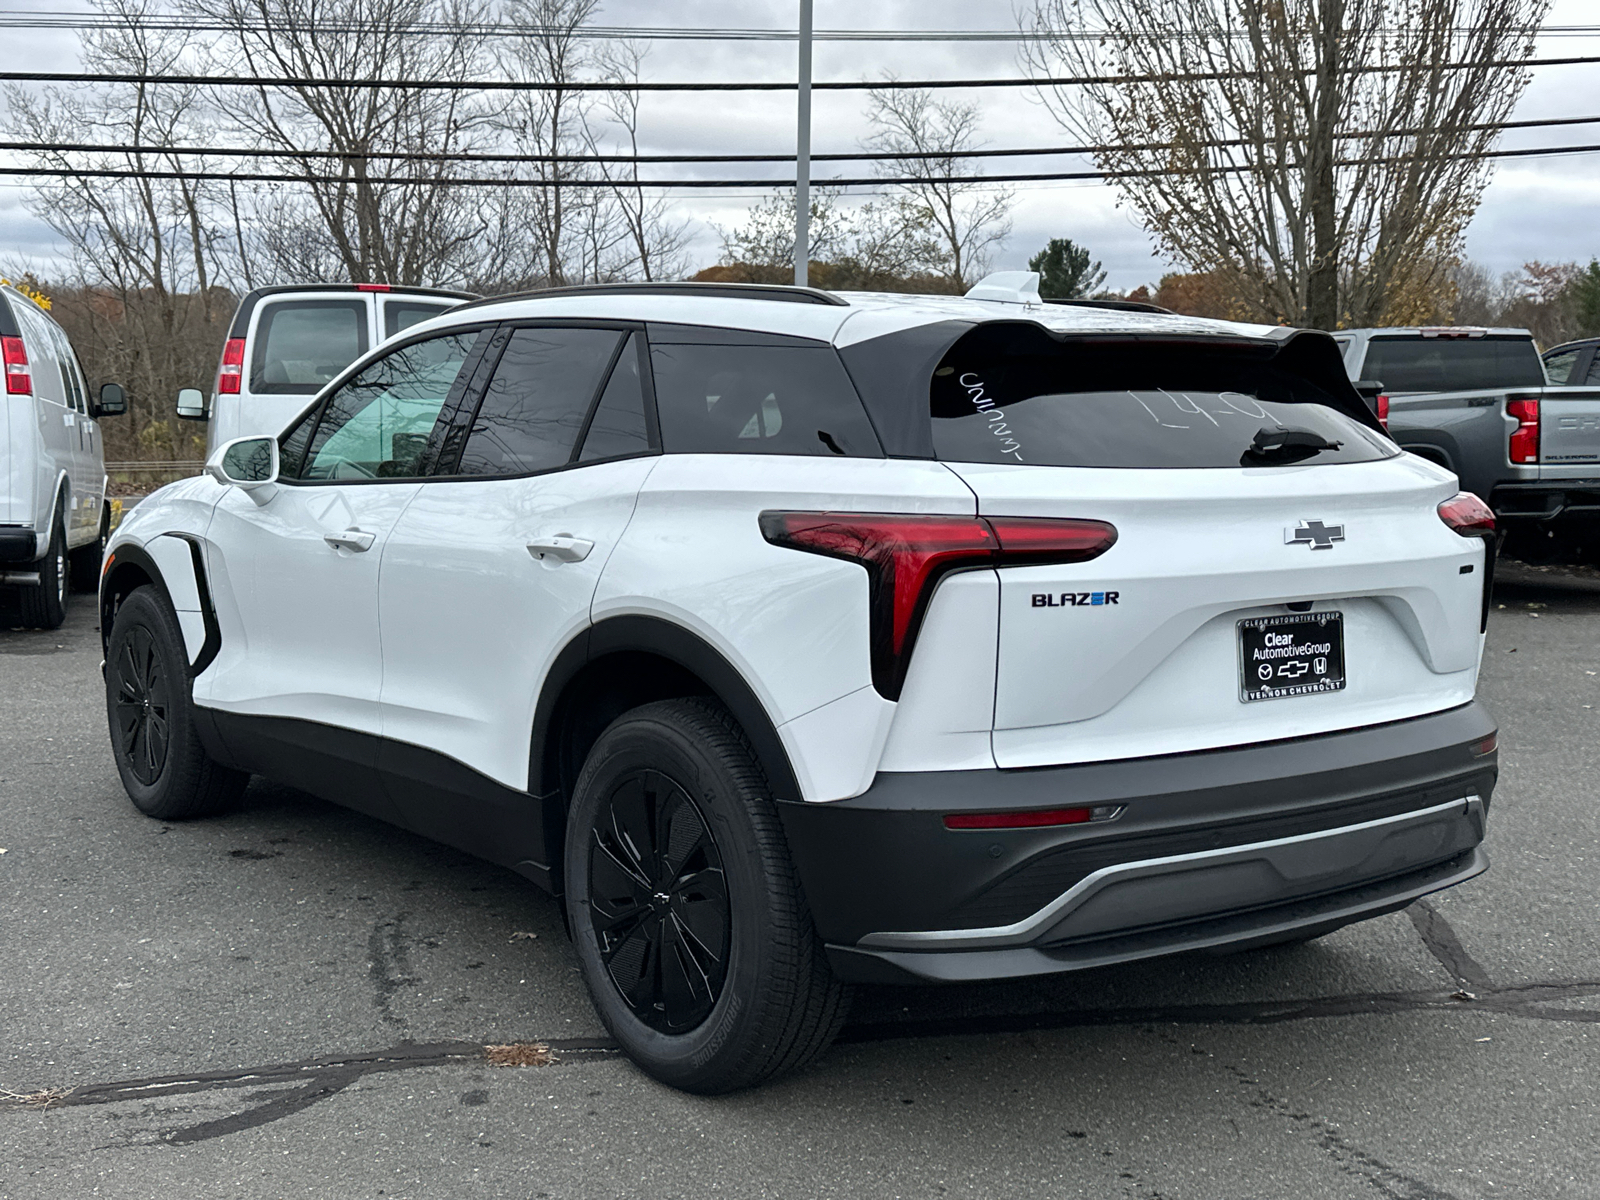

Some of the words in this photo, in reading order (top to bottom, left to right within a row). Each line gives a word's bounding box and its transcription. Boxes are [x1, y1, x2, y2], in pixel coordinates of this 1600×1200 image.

[1031, 591, 1119, 607] BLAZER
[1245, 618, 1269, 627] CLEAR
[1270, 614, 1315, 625] AUTOMOTIVE
[1316, 612, 1340, 621] GROUP
[1264, 632, 1294, 647] Clear
[1290, 682, 1341, 695] CHEVROLET
